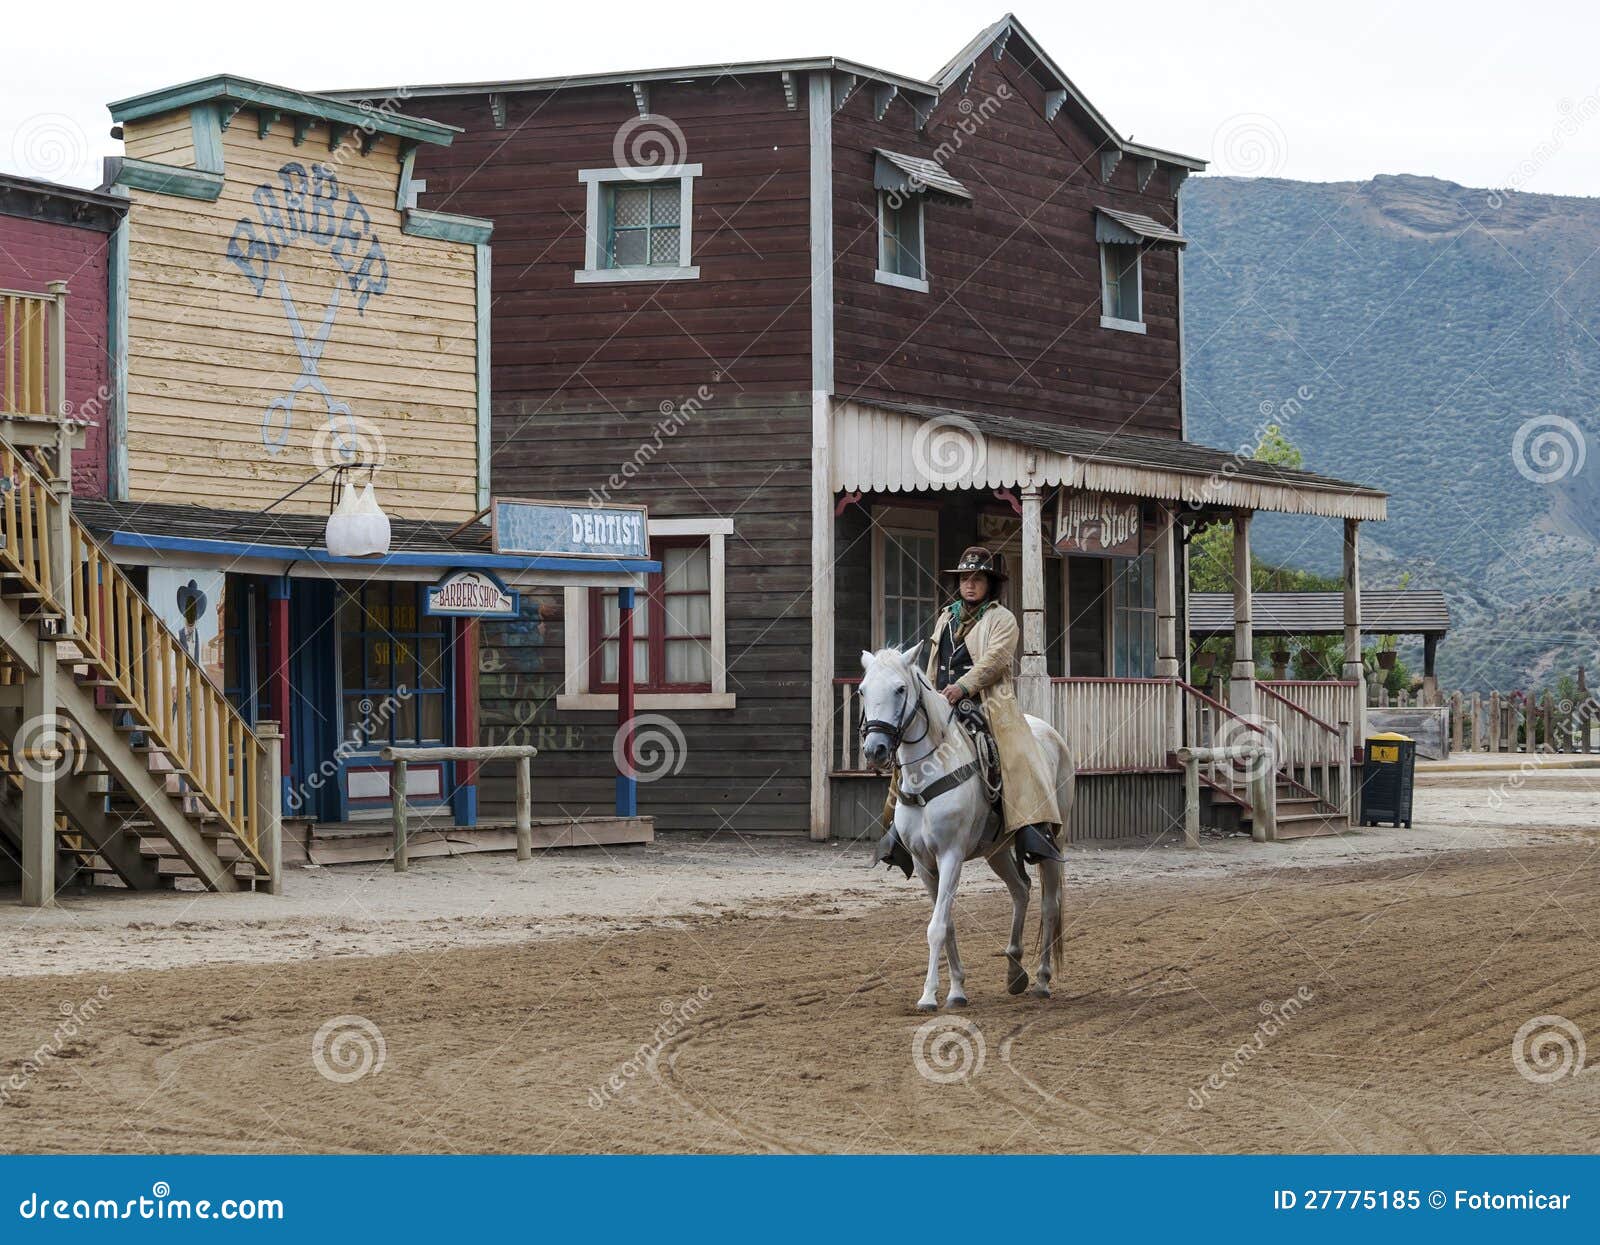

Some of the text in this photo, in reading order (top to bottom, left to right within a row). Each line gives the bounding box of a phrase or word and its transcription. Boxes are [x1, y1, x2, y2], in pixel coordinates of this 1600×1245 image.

[226, 162, 389, 317] BARBER
[571, 513, 640, 545] DENTIST
[479, 584, 499, 608] SHOP
